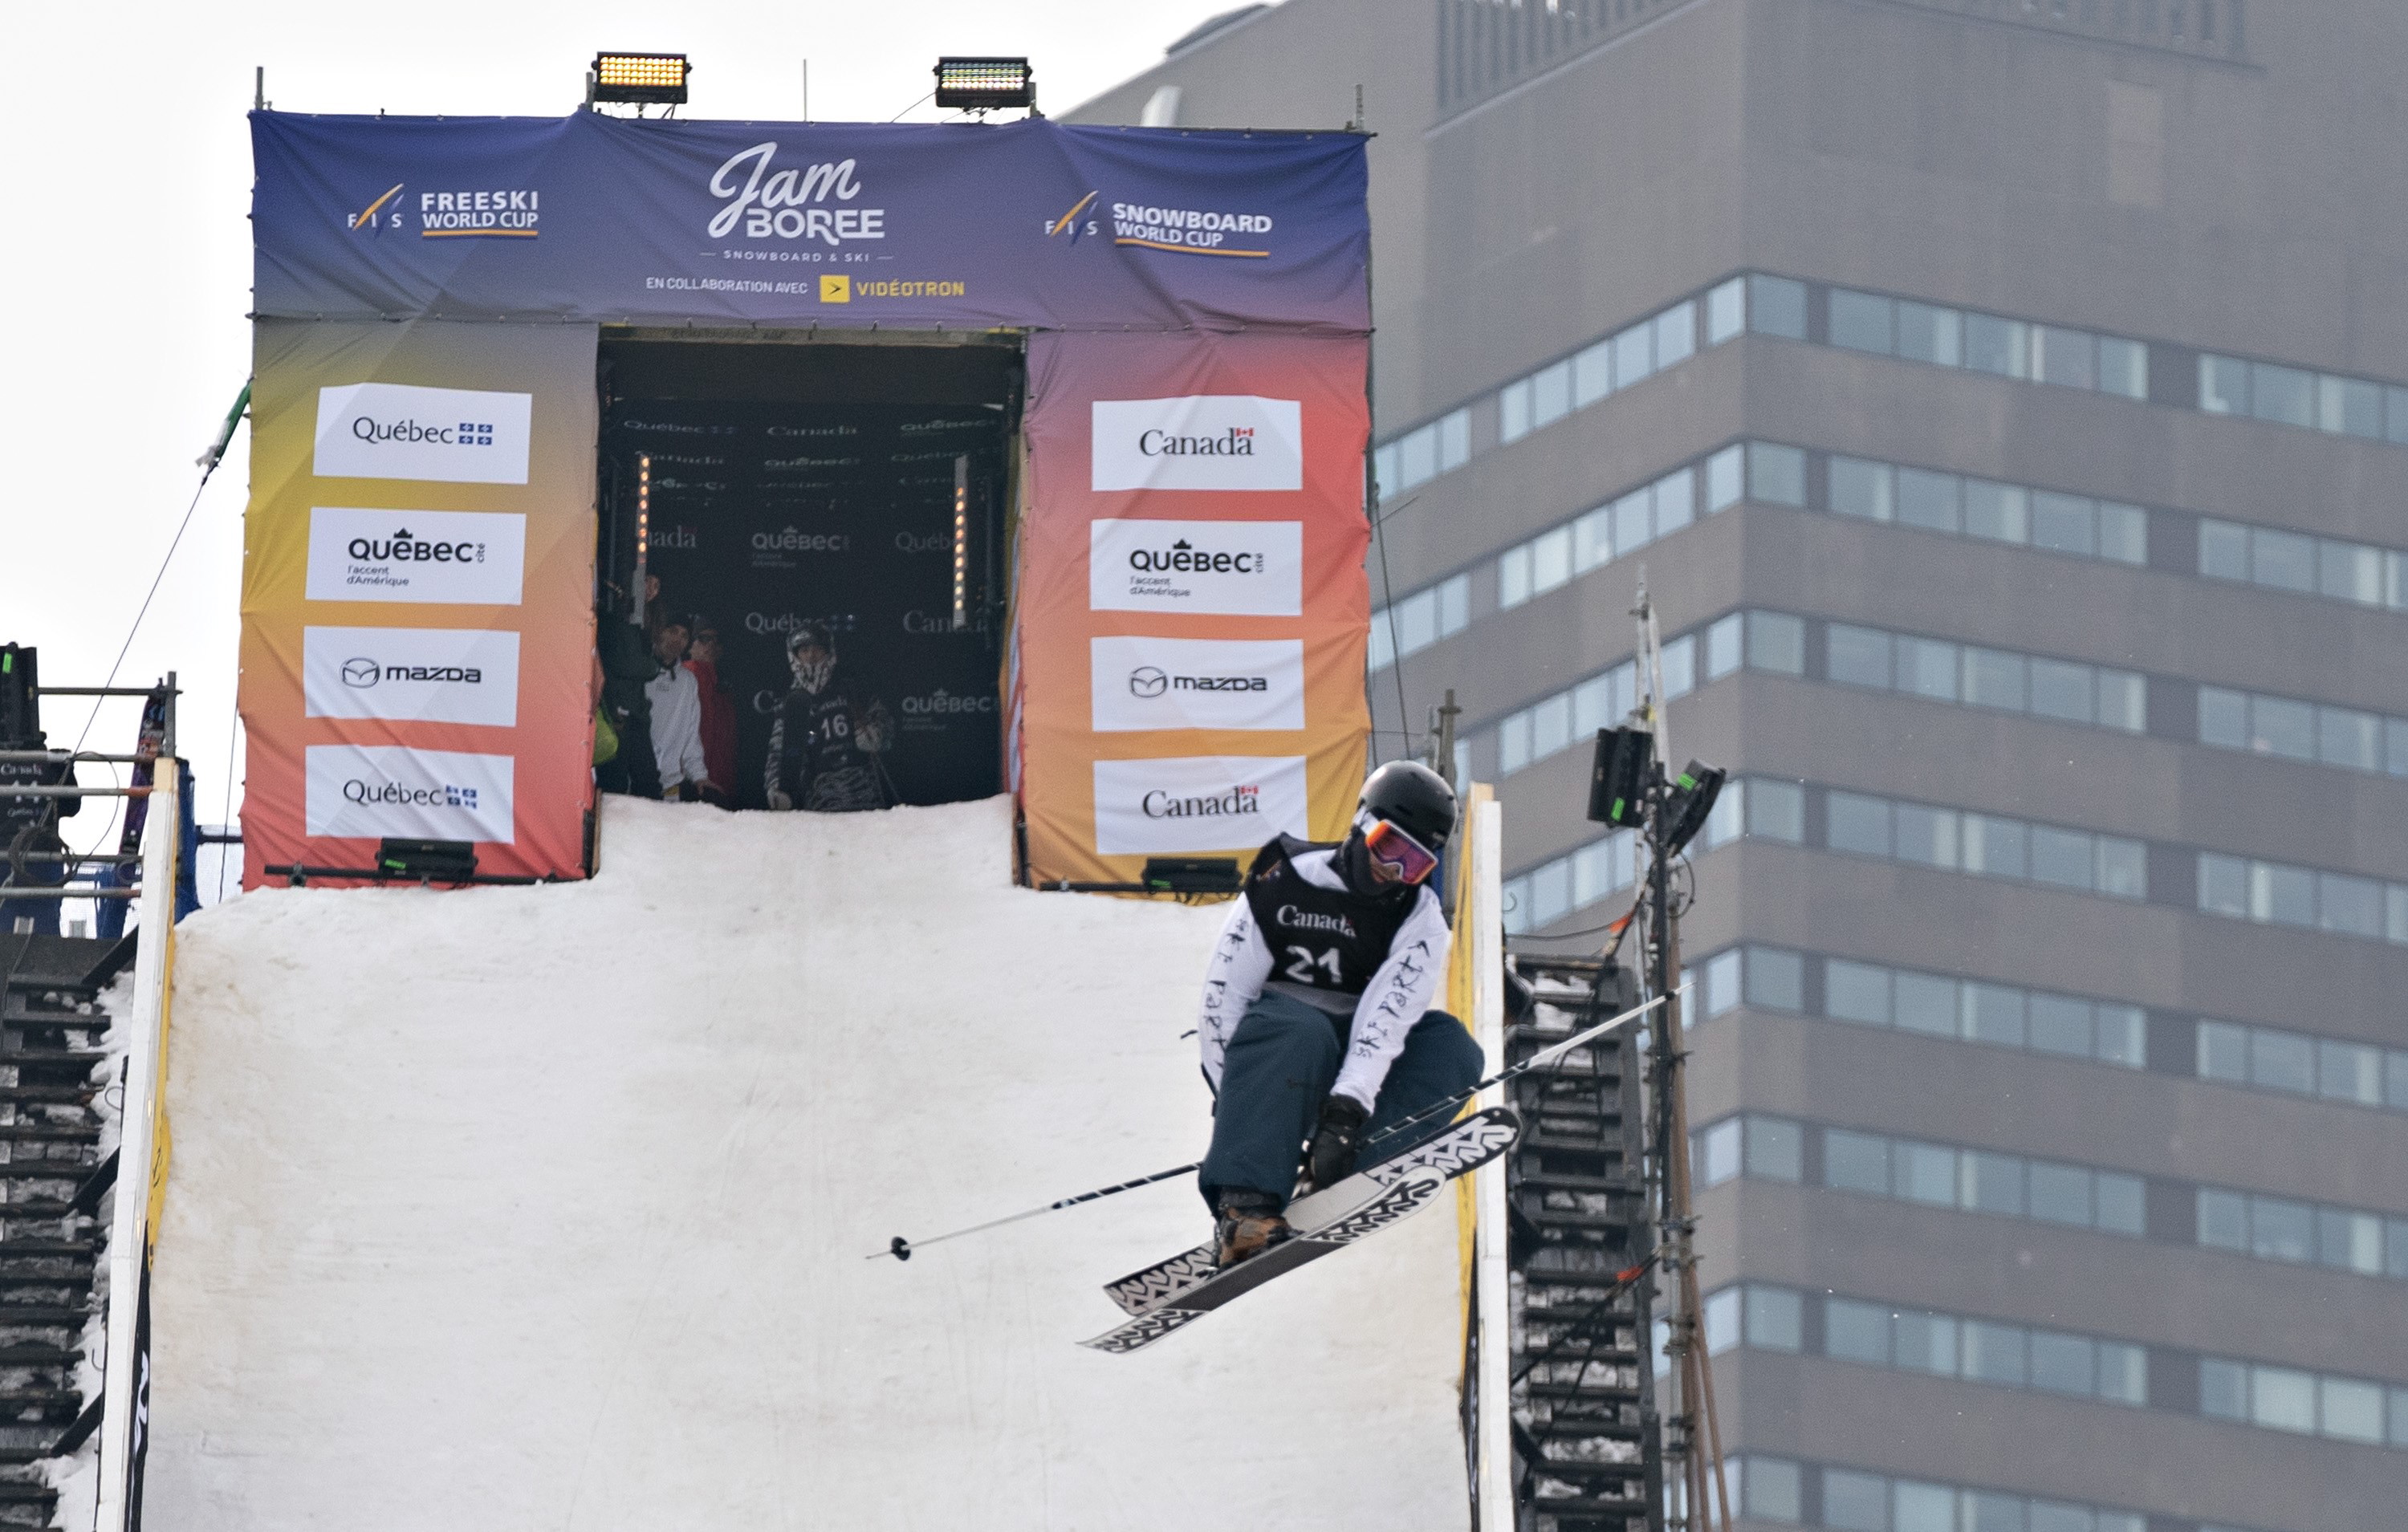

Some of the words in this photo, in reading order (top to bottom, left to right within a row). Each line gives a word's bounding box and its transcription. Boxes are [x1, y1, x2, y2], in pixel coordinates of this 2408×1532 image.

[421, 190, 539, 211] FREESKI
[707, 141, 861, 238] Jam
[421, 212, 496, 229] WORLD
[498, 211, 539, 229] CUP
[746, 208, 885, 246] BOREE
[1112, 203, 1273, 233] SNOWBOARD
[1113, 221, 1184, 244] WORLD
[1185, 230, 1224, 247] CUP
[723, 250, 823, 262] SNOWBOARD
[828, 252, 838, 262] &
[844, 253, 870, 262] SKI
[645, 277, 665, 289] EN
[665, 277, 773, 293] COLLABORATION
[774, 282, 809, 295] AVEC
[856, 278, 966, 297] VIDÉOTRON
[352, 417, 454, 444] Québec
[1139, 427, 1255, 456] Canada
[820, 713, 848, 739] 16
[343, 778, 443, 807] Québec
[1142, 785, 1259, 819] Canada
[1276, 904, 1357, 938] Canada
[1286, 945, 1342, 984] 21
